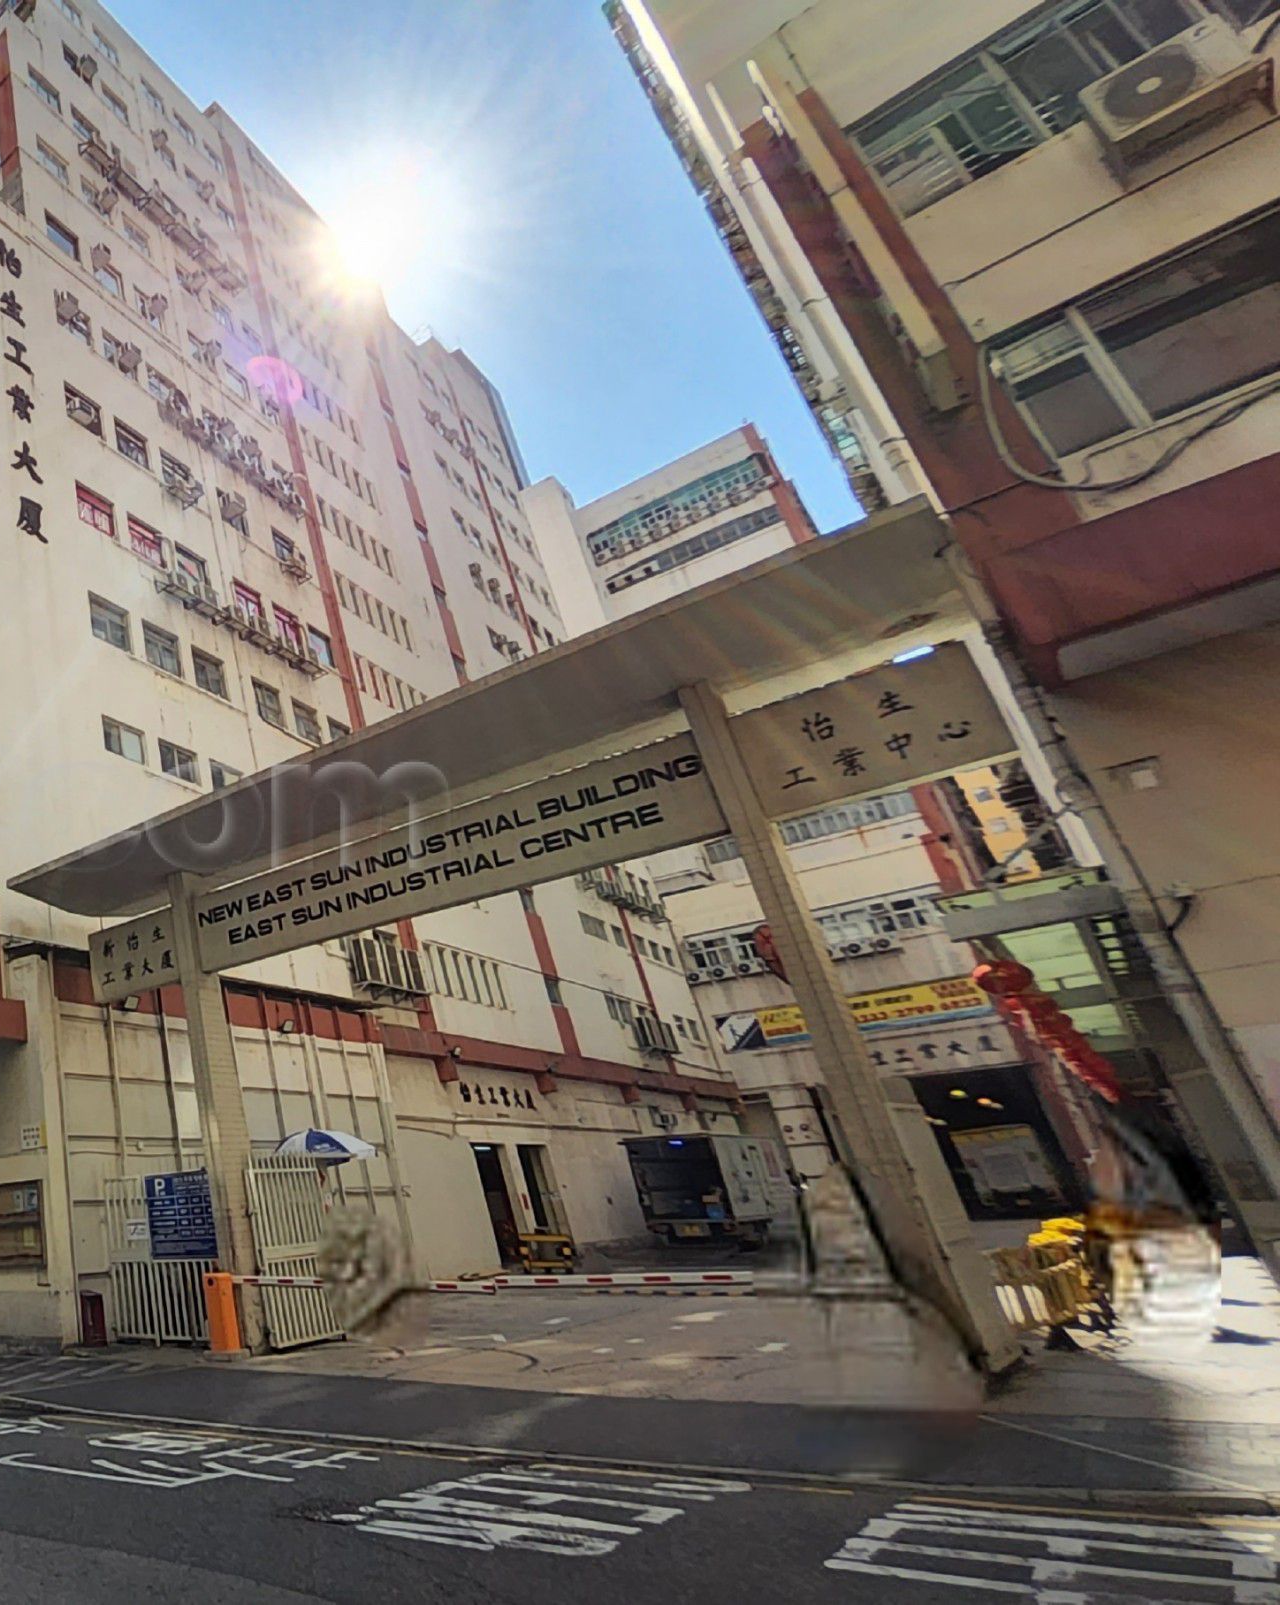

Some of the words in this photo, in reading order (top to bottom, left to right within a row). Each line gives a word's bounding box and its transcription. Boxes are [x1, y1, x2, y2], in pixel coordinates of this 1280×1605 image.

[801, 691, 915, 742] 怡生
[782, 720, 971, 790] 工業中心
[198, 901, 244, 929] NEW
[246, 879, 306, 913] EAST
[310, 861, 363, 892] SUN
[365, 810, 535, 875] INDUSTRIAL
[539, 754, 704, 820] BUILDING
[227, 913, 287, 946] EAST
[291, 896, 343, 927] SUN
[346, 846, 516, 911] INDUSTRIAL
[519, 803, 665, 859] CENTRE
[102, 925, 166, 958] 新怡生
[154, 1178, 166, 1197] P
[355, 1464, 753, 1558] CLEAR
